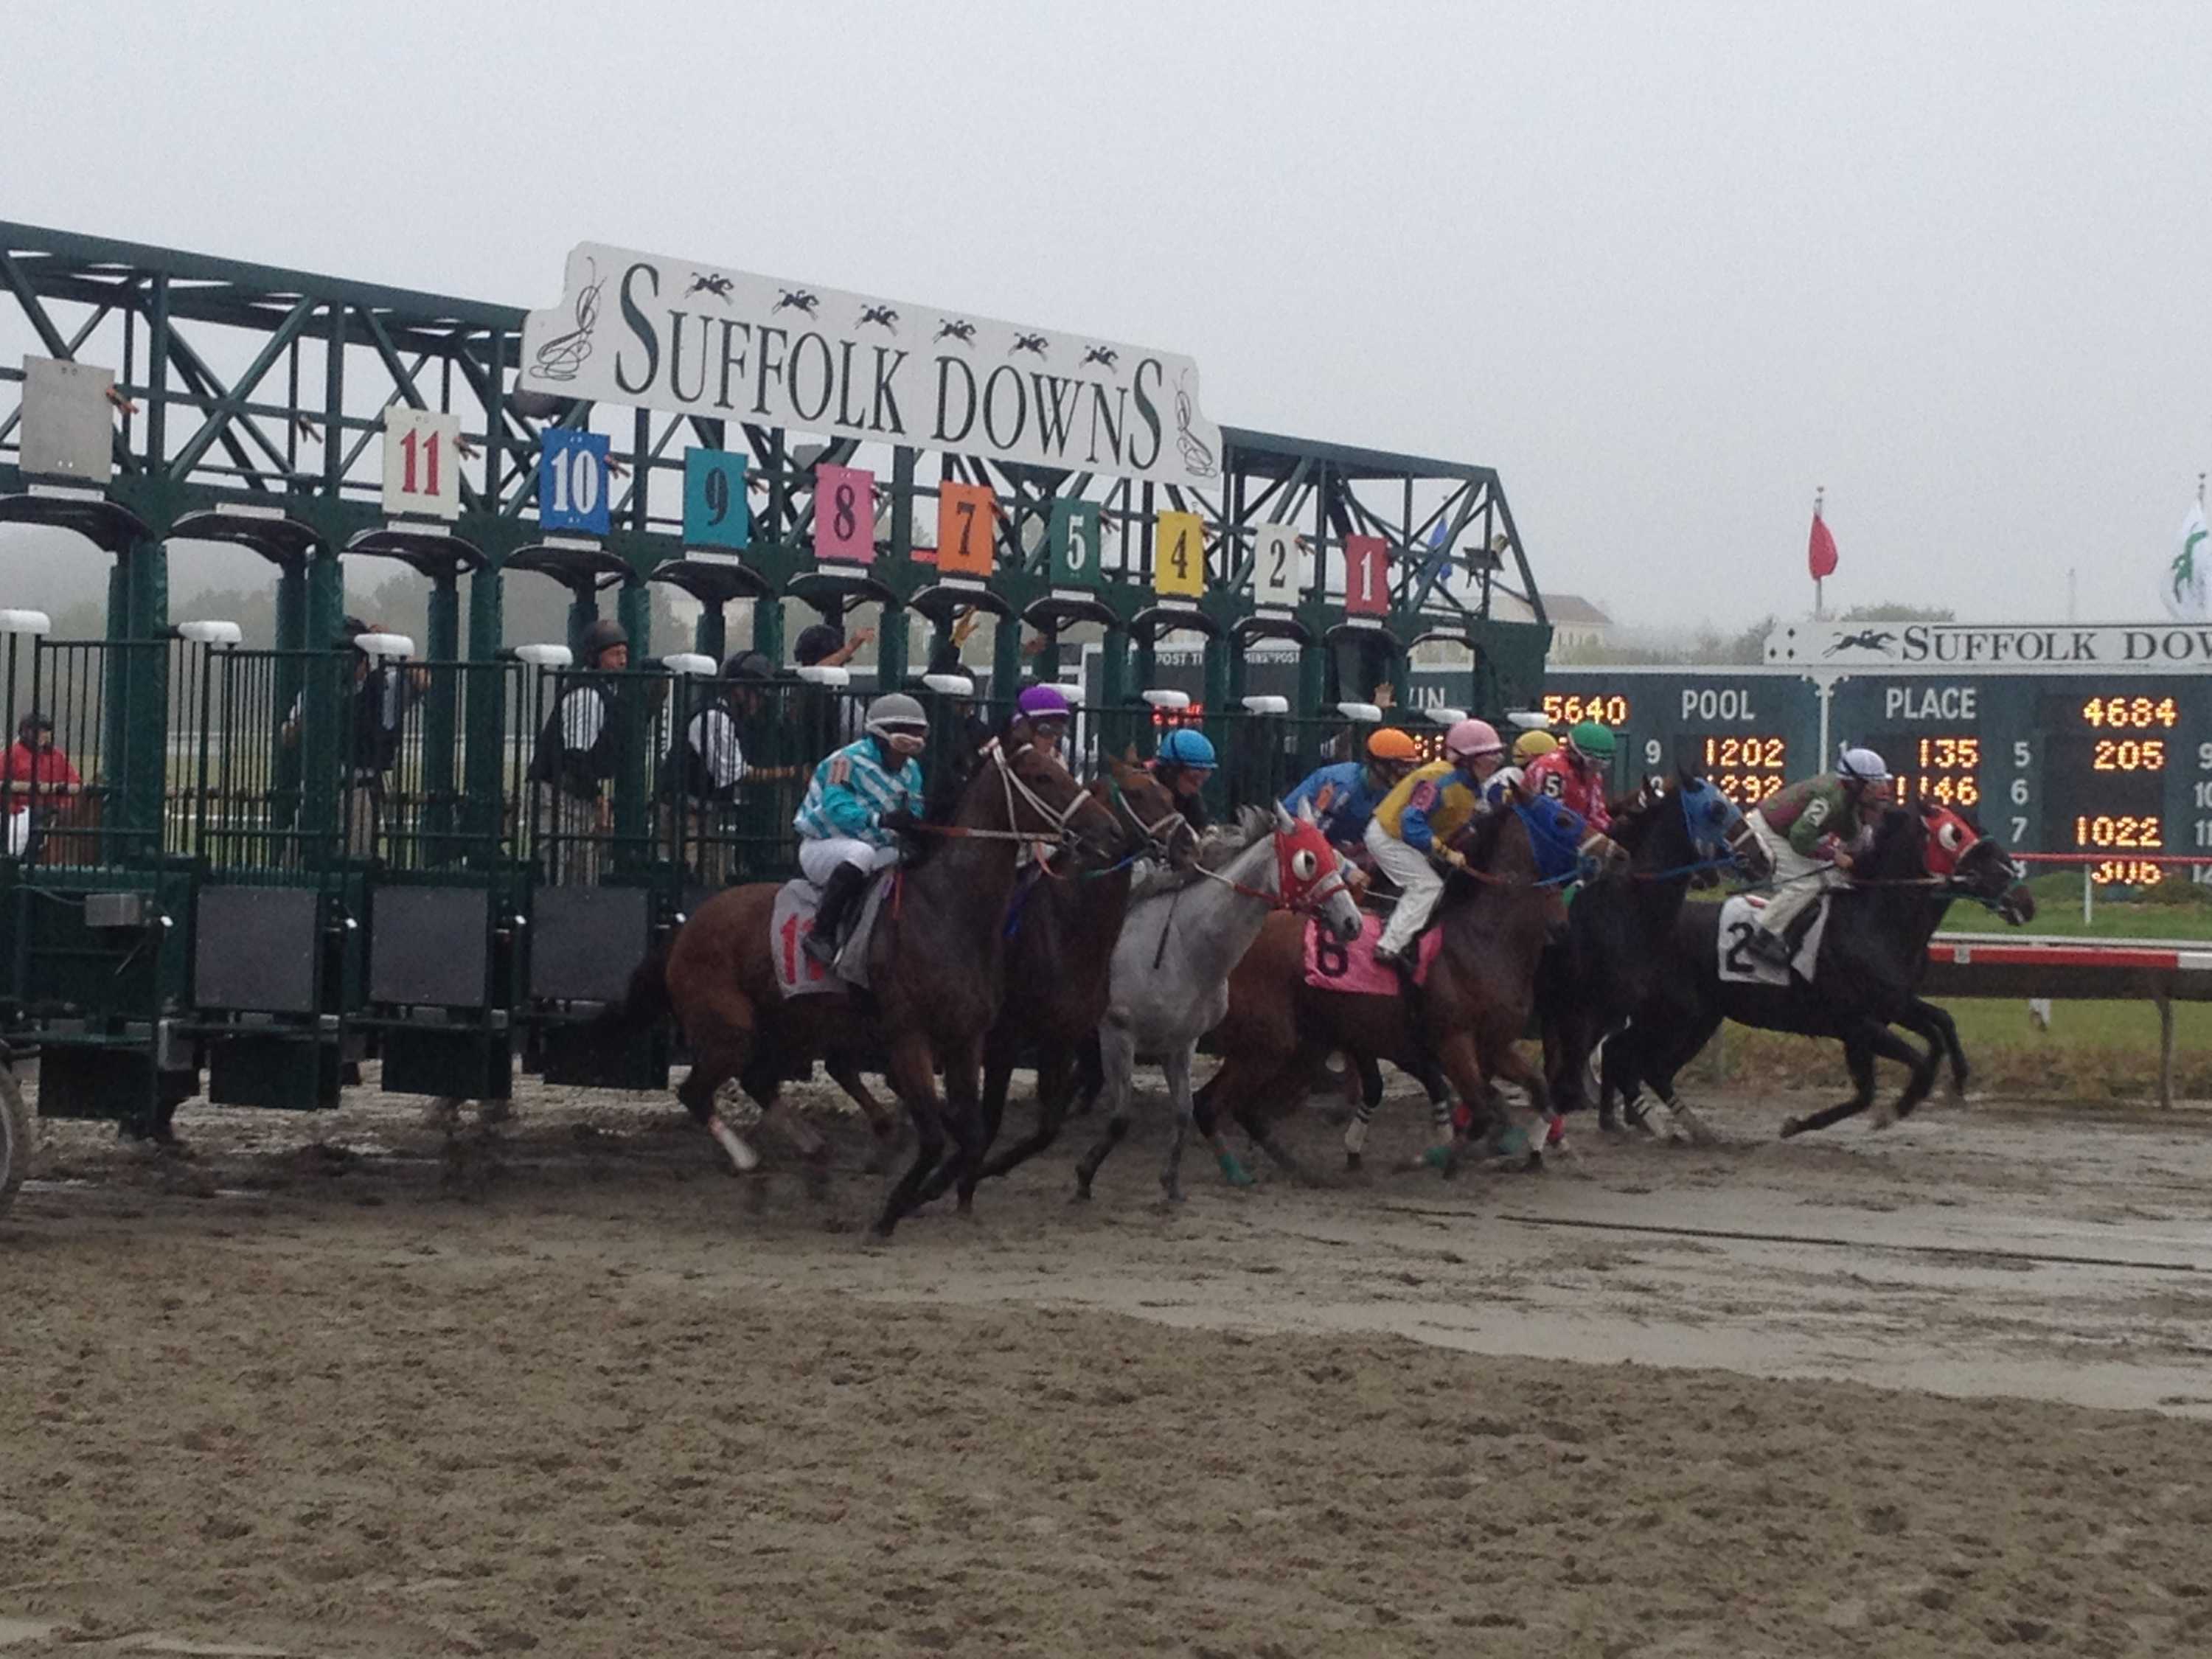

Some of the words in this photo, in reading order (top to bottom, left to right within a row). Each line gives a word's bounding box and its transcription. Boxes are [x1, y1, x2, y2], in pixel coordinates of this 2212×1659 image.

[615, 262, 908, 436] SUFFOLK
[931, 357, 1163, 470] DOWNS
[400, 428, 440, 495] 11
[551, 448, 599, 514] 10
[705, 466, 728, 526] 9
[833, 484, 856, 541] 8
[956, 501, 976, 556] 7
[1066, 516, 1086, 570] 5
[1170, 529, 1189, 580] 4
[1269, 538, 1286, 588] 2
[1360, 551, 1372, 601] 1
[1902, 626, 2098, 661] SUFFOLK
[1409, 686, 1444, 708] IN
[1543, 695, 1626, 725] 5640
[1681, 689, 1756, 720] POOL
[1885, 687, 1977, 720] PLACE
[2083, 698, 2177, 727] 4684
[1645, 740, 1662, 765] 9
[1706, 738, 1784, 767] 1202
[1920, 739, 1978, 768] 135
[2014, 741, 2030, 768] 5
[2093, 740, 2164, 770] 205
[2199, 742, 2212, 770] 9
[1545, 774, 1560, 797] 5
[1707, 775, 1783, 804] 292
[2011, 779, 2028, 805] 6
[1809, 797, 1829, 827] 2
[2011, 817, 2027, 843] 7
[2076, 816, 2162, 846] 1022
[1727, 922, 1756, 973] 2
